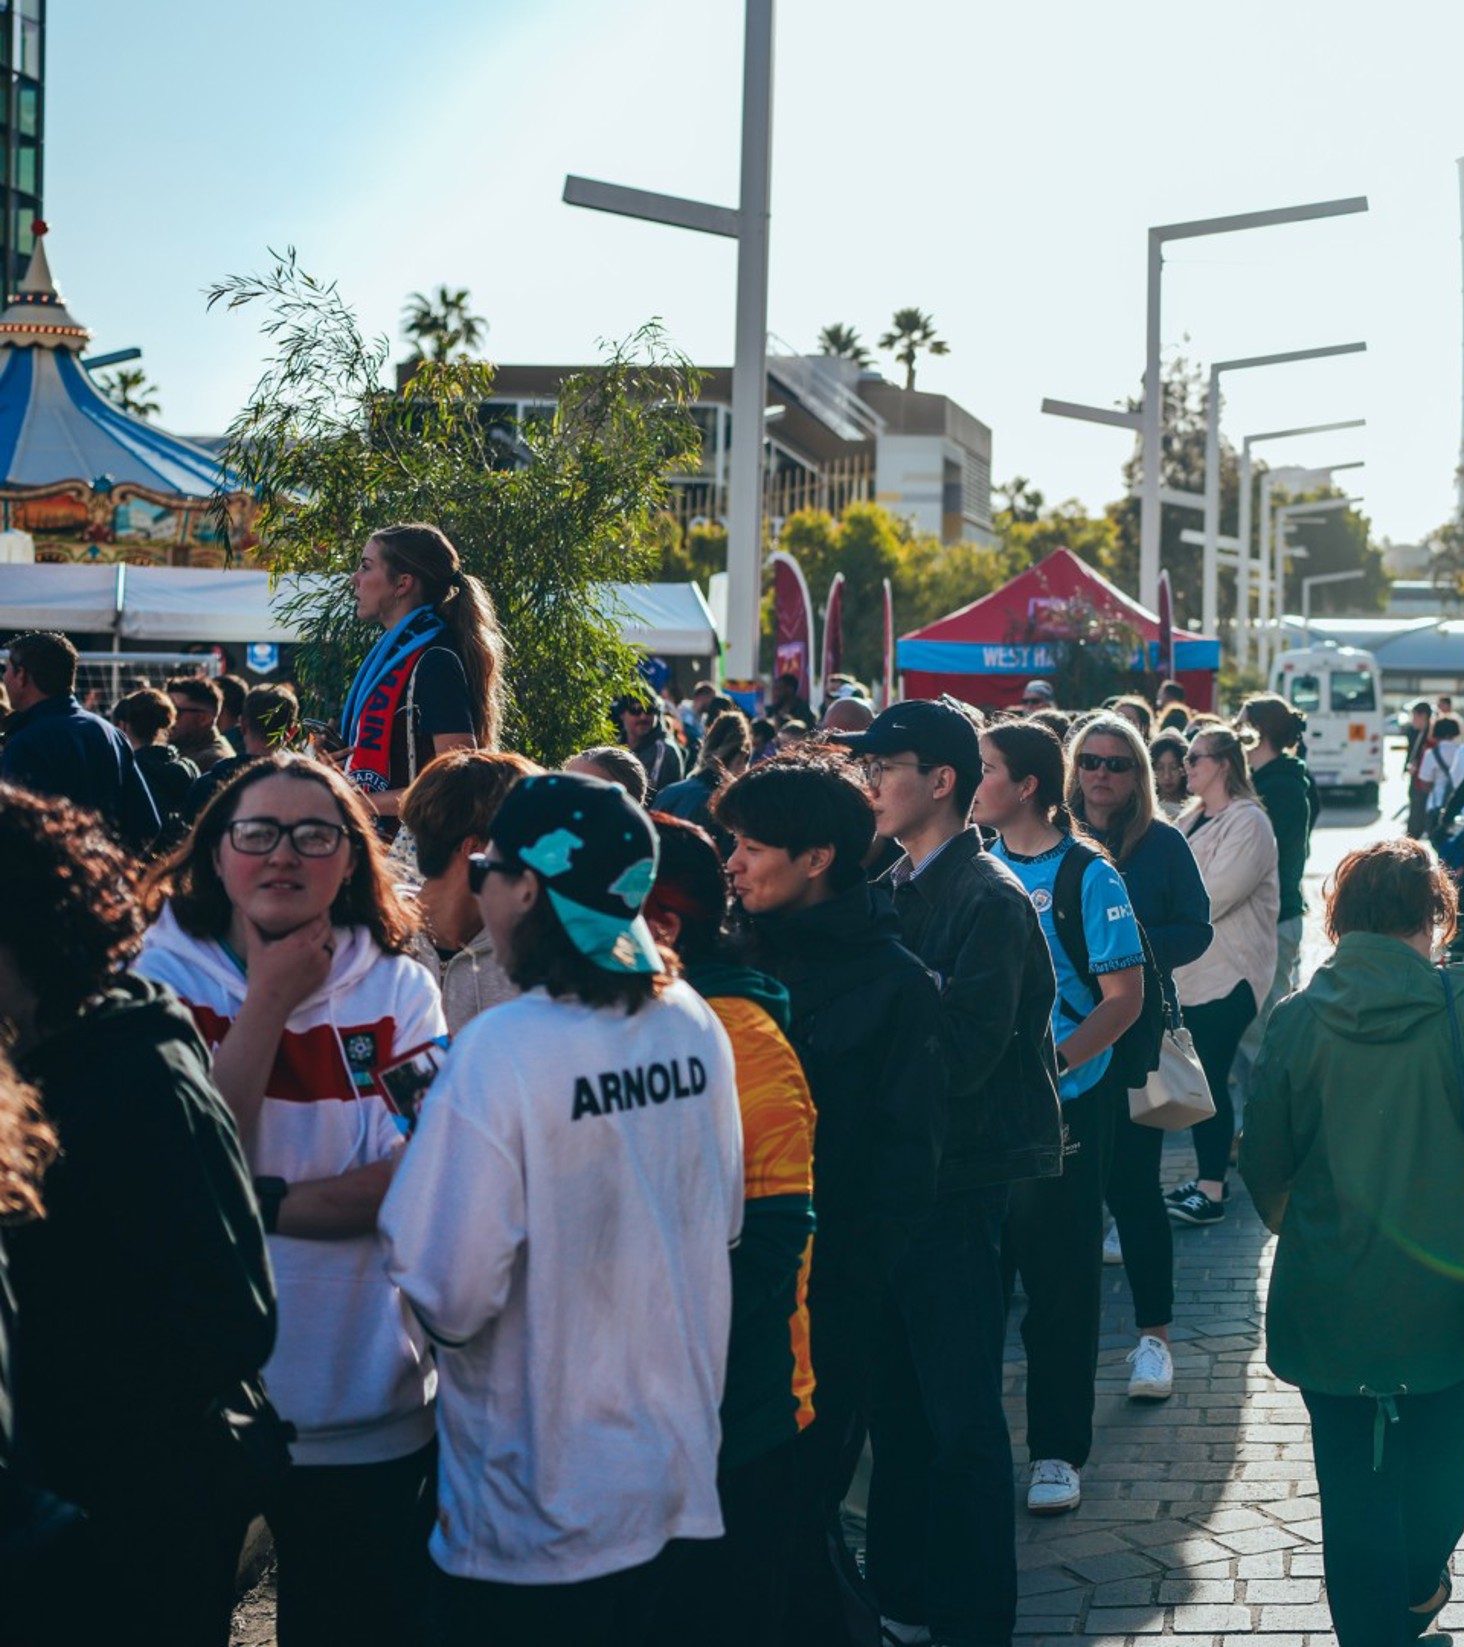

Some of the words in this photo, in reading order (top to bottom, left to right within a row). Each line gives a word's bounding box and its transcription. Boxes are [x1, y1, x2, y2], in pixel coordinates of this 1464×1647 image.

[983, 646, 1030, 668] WEST
[1034, 646, 1058, 668] HA
[571, 1055, 707, 1122] ARNOLD
